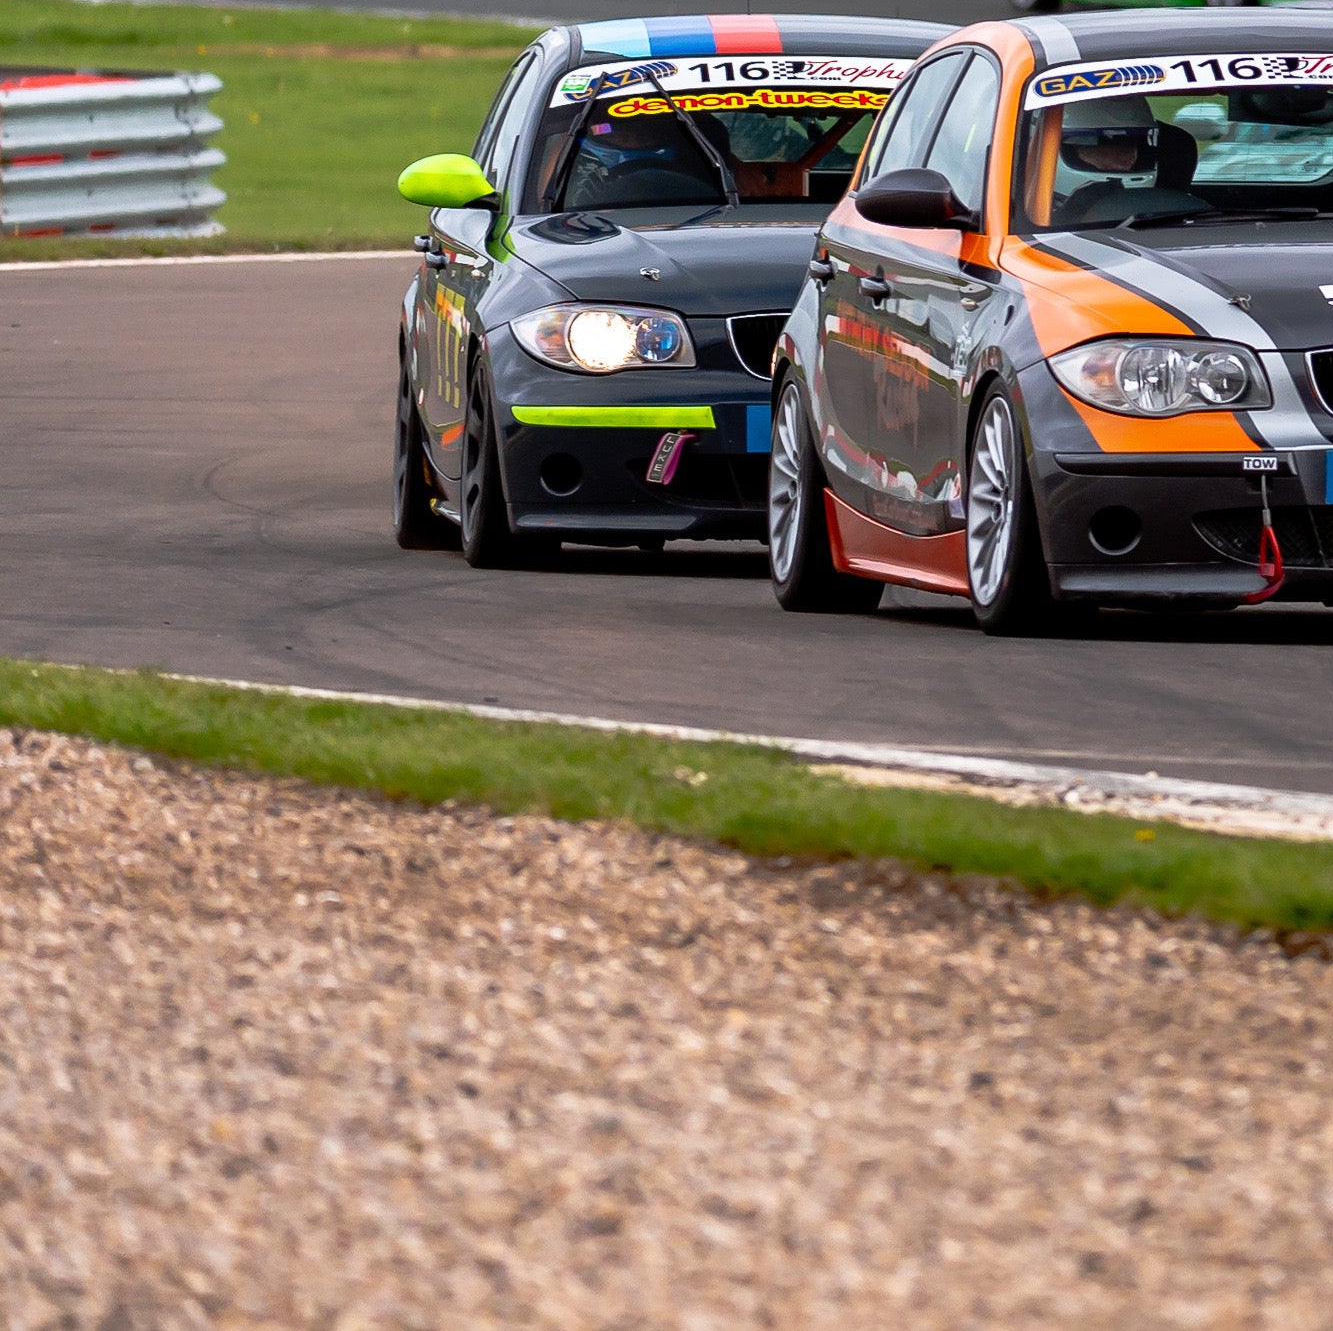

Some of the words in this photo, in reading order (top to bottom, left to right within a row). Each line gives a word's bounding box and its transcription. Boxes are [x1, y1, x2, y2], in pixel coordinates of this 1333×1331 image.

[688, 61, 770, 83] 116
[1170, 57, 1263, 83] 116
[1040, 71, 1119, 94] GAZ
[1244, 458, 1276, 469] TOW
